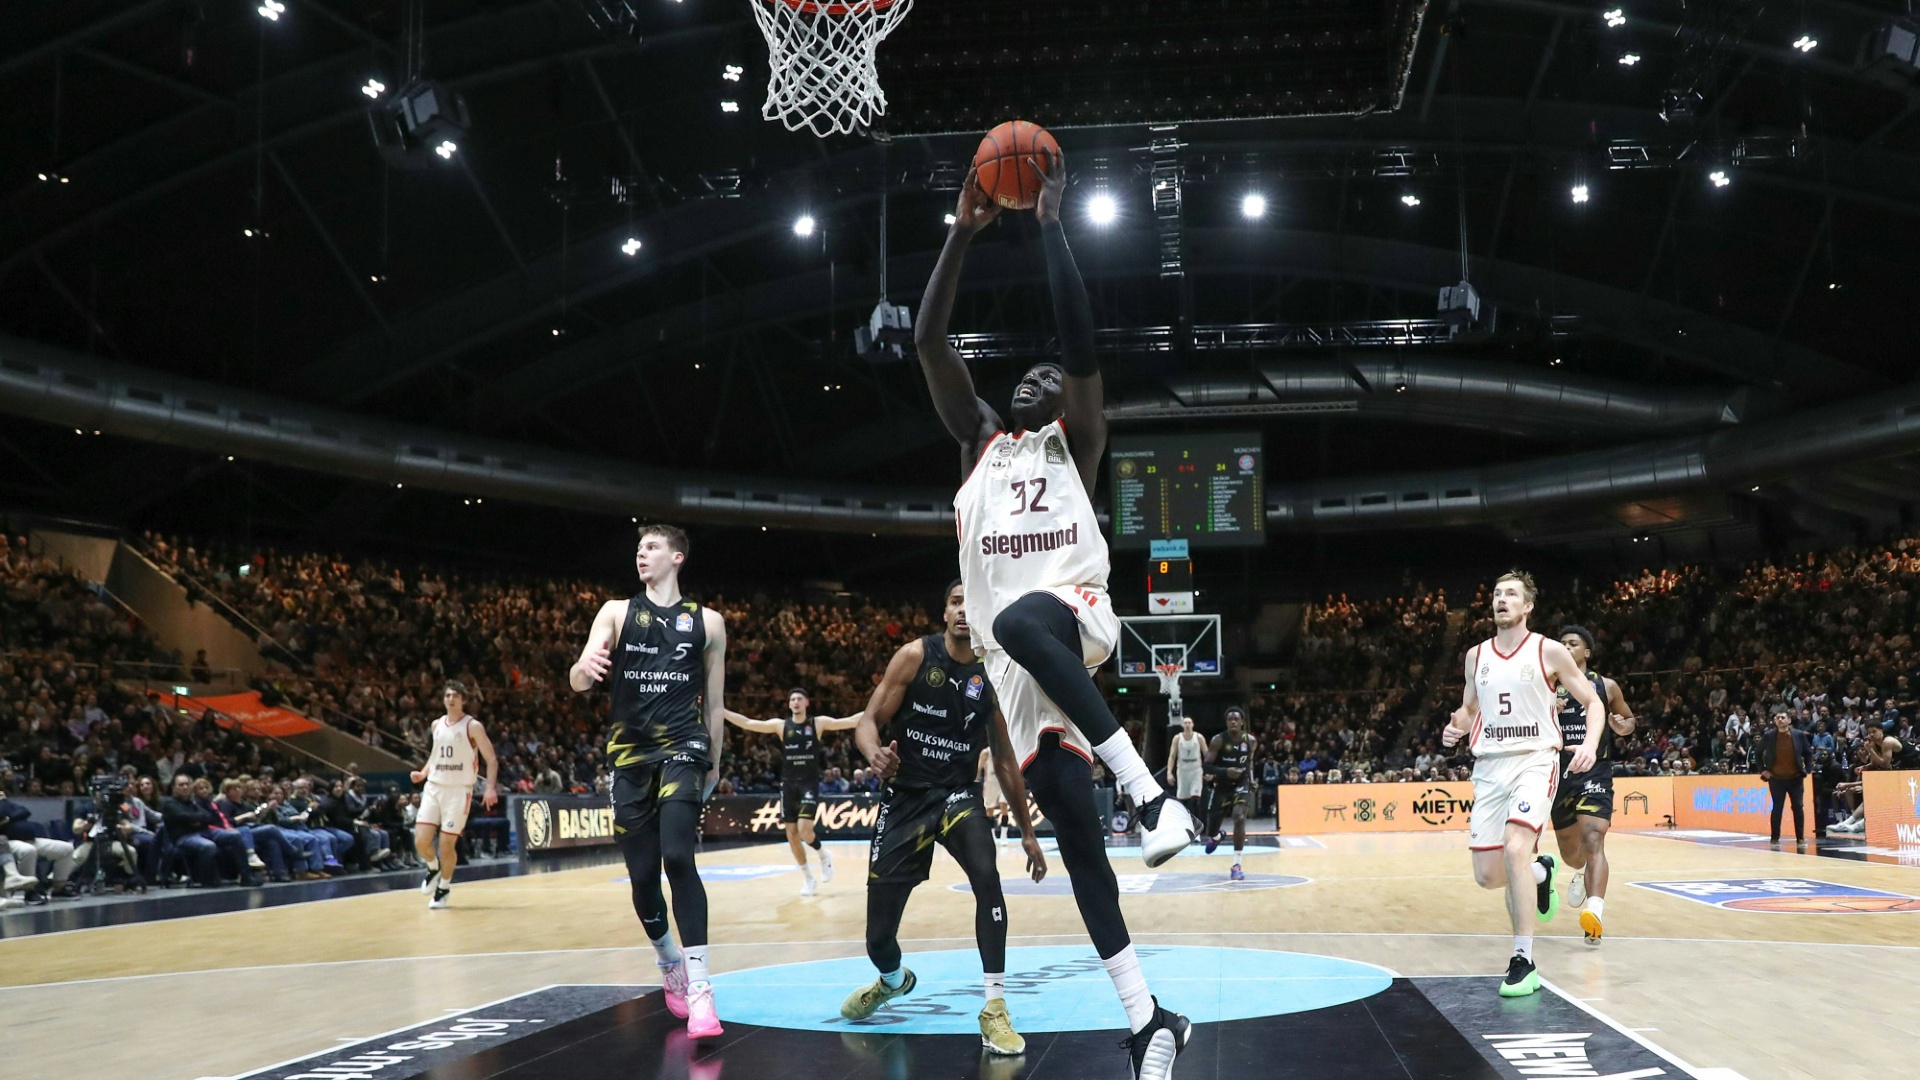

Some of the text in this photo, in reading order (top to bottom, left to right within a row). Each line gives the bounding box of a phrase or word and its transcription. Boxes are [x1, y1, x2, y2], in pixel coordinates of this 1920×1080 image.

[1010, 478, 1049, 516] 32
[982, 522, 1078, 559] siegmund
[1160, 562, 1168, 573] 8
[672, 643, 693, 660] 5
[624, 670, 689, 681] VOLKSWAGEN
[639, 684, 668, 693] BANK
[1498, 693, 1511, 715] 5
[906, 728, 970, 751] VOLKSWAGEN
[440, 746, 453, 758] 10
[922, 747, 952, 761] BANK
[559, 808, 615, 838] BASKET
